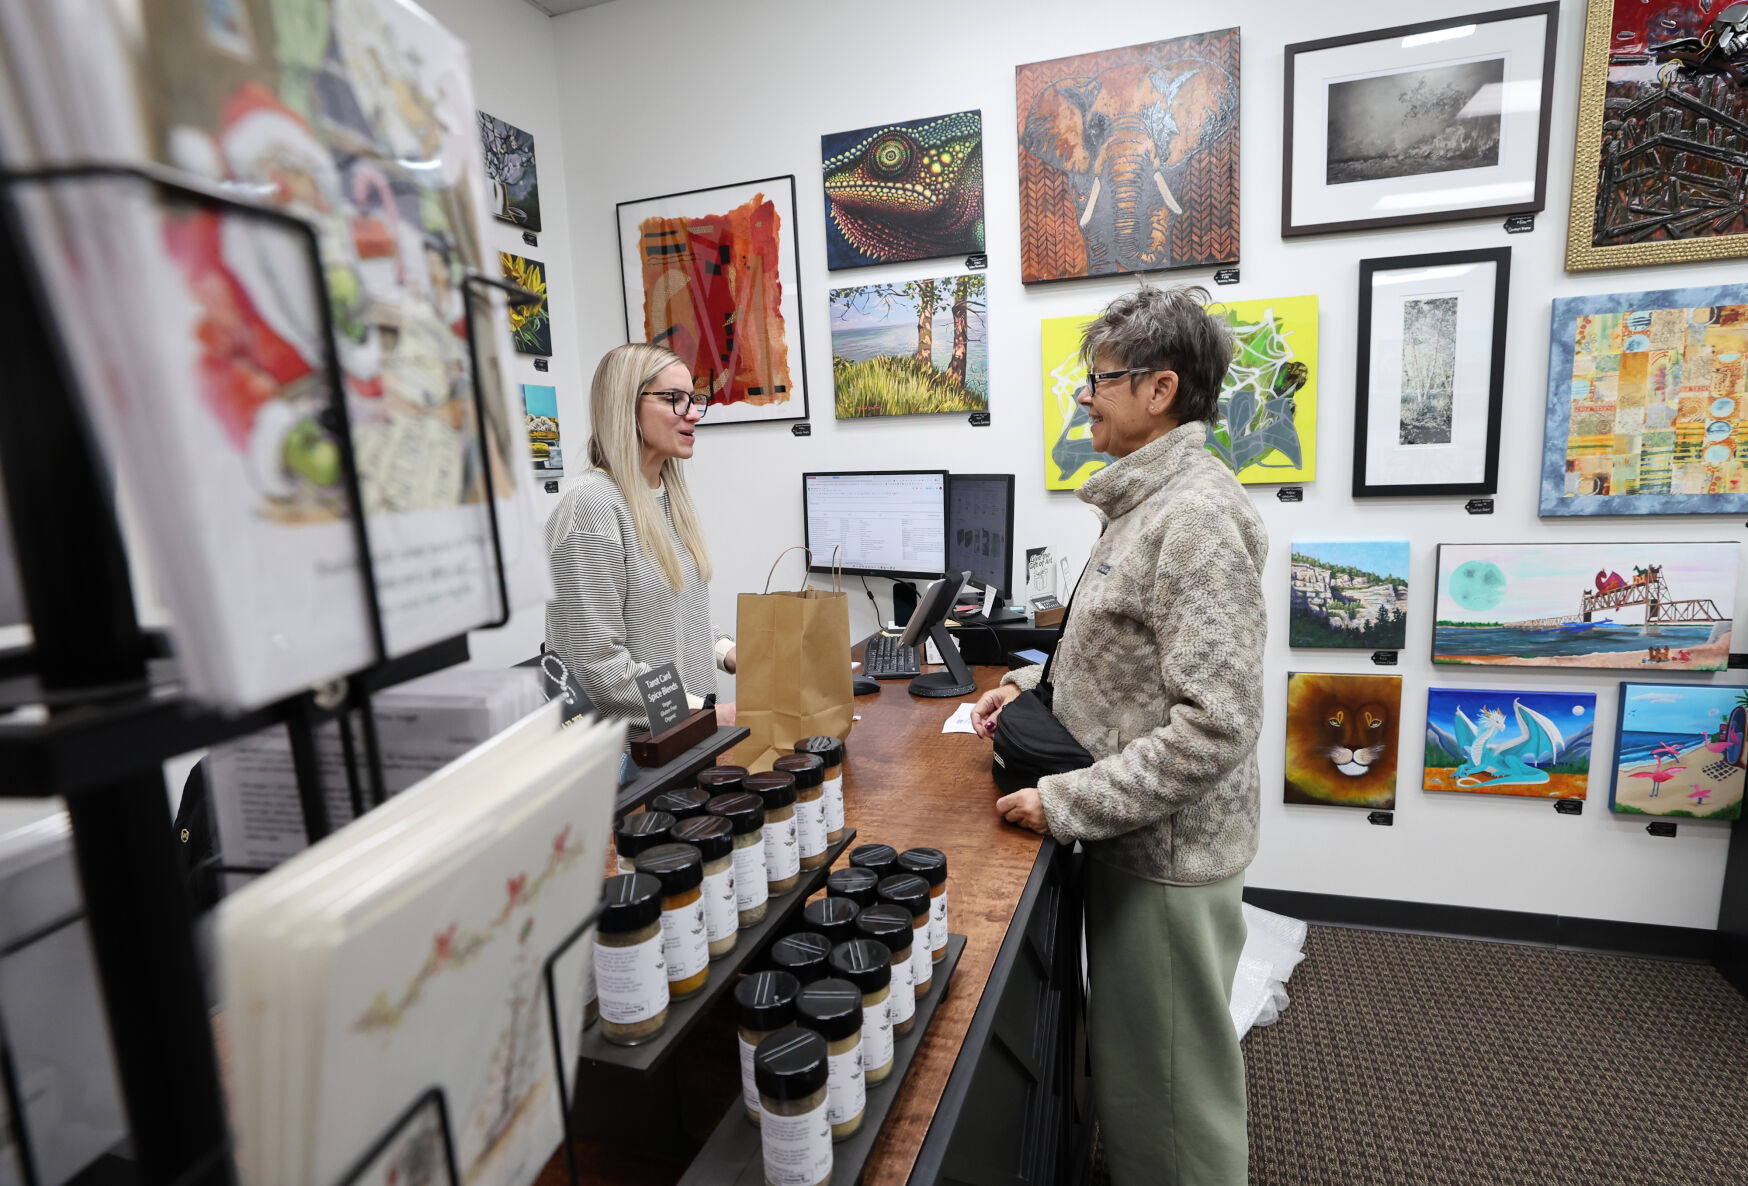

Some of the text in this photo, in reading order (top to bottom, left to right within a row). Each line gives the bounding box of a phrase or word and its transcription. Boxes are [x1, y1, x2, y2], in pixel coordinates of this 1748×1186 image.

[645, 671, 672, 689] Tarot Card
[647, 682, 679, 703] Spice Blends
